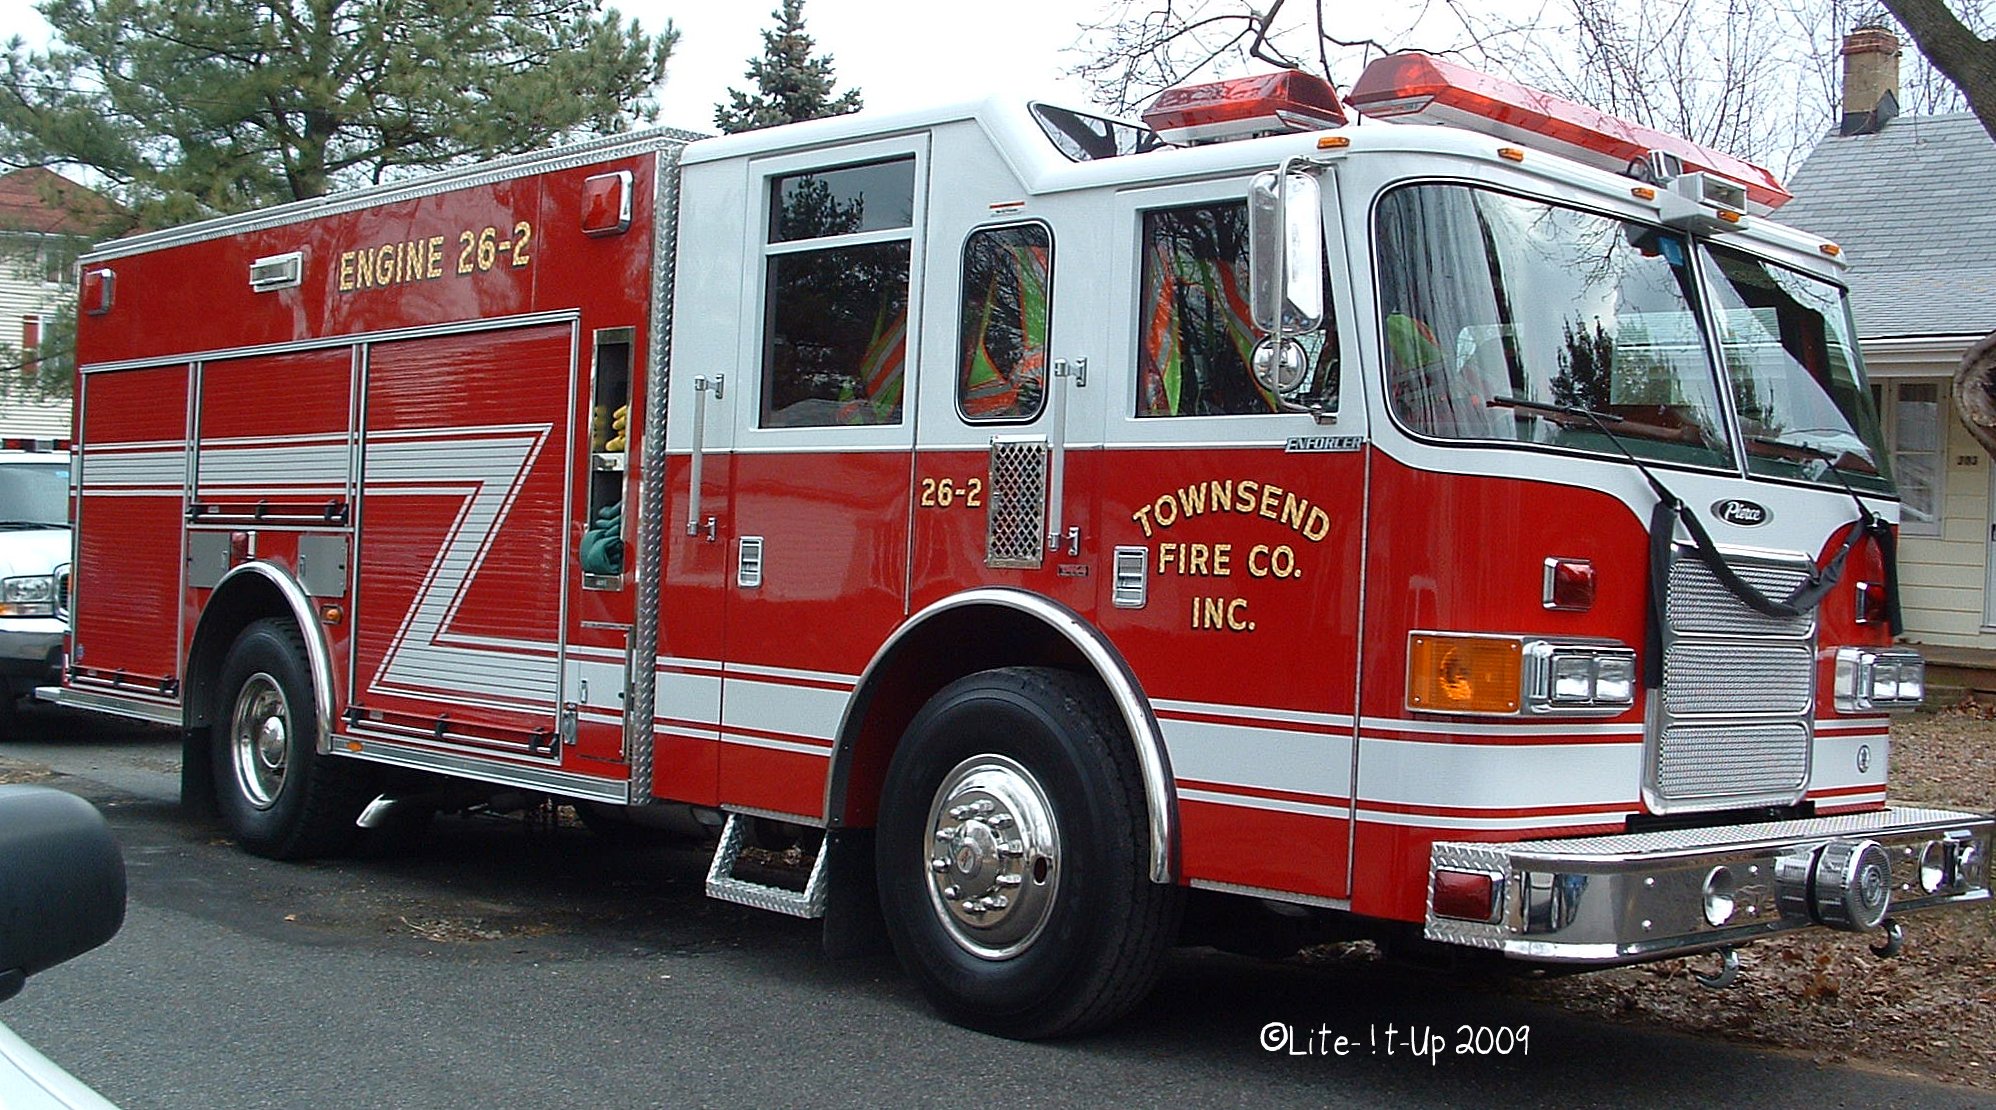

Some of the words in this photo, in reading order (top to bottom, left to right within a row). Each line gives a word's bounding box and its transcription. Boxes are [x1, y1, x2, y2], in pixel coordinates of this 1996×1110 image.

[339, 236, 445, 292] ENGINE
[457, 221, 532, 275] 26-2
[1285, 437, 1363, 450] ENFORCER
[921, 478, 982, 507] 26-2
[1132, 479, 1331, 542] TOWNSEND
[1724, 501, 1761, 521] Pierce
[1158, 543, 1232, 576] FIRE
[1248, 544, 1302, 578] CO.
[1192, 597, 1256, 631] INC.
